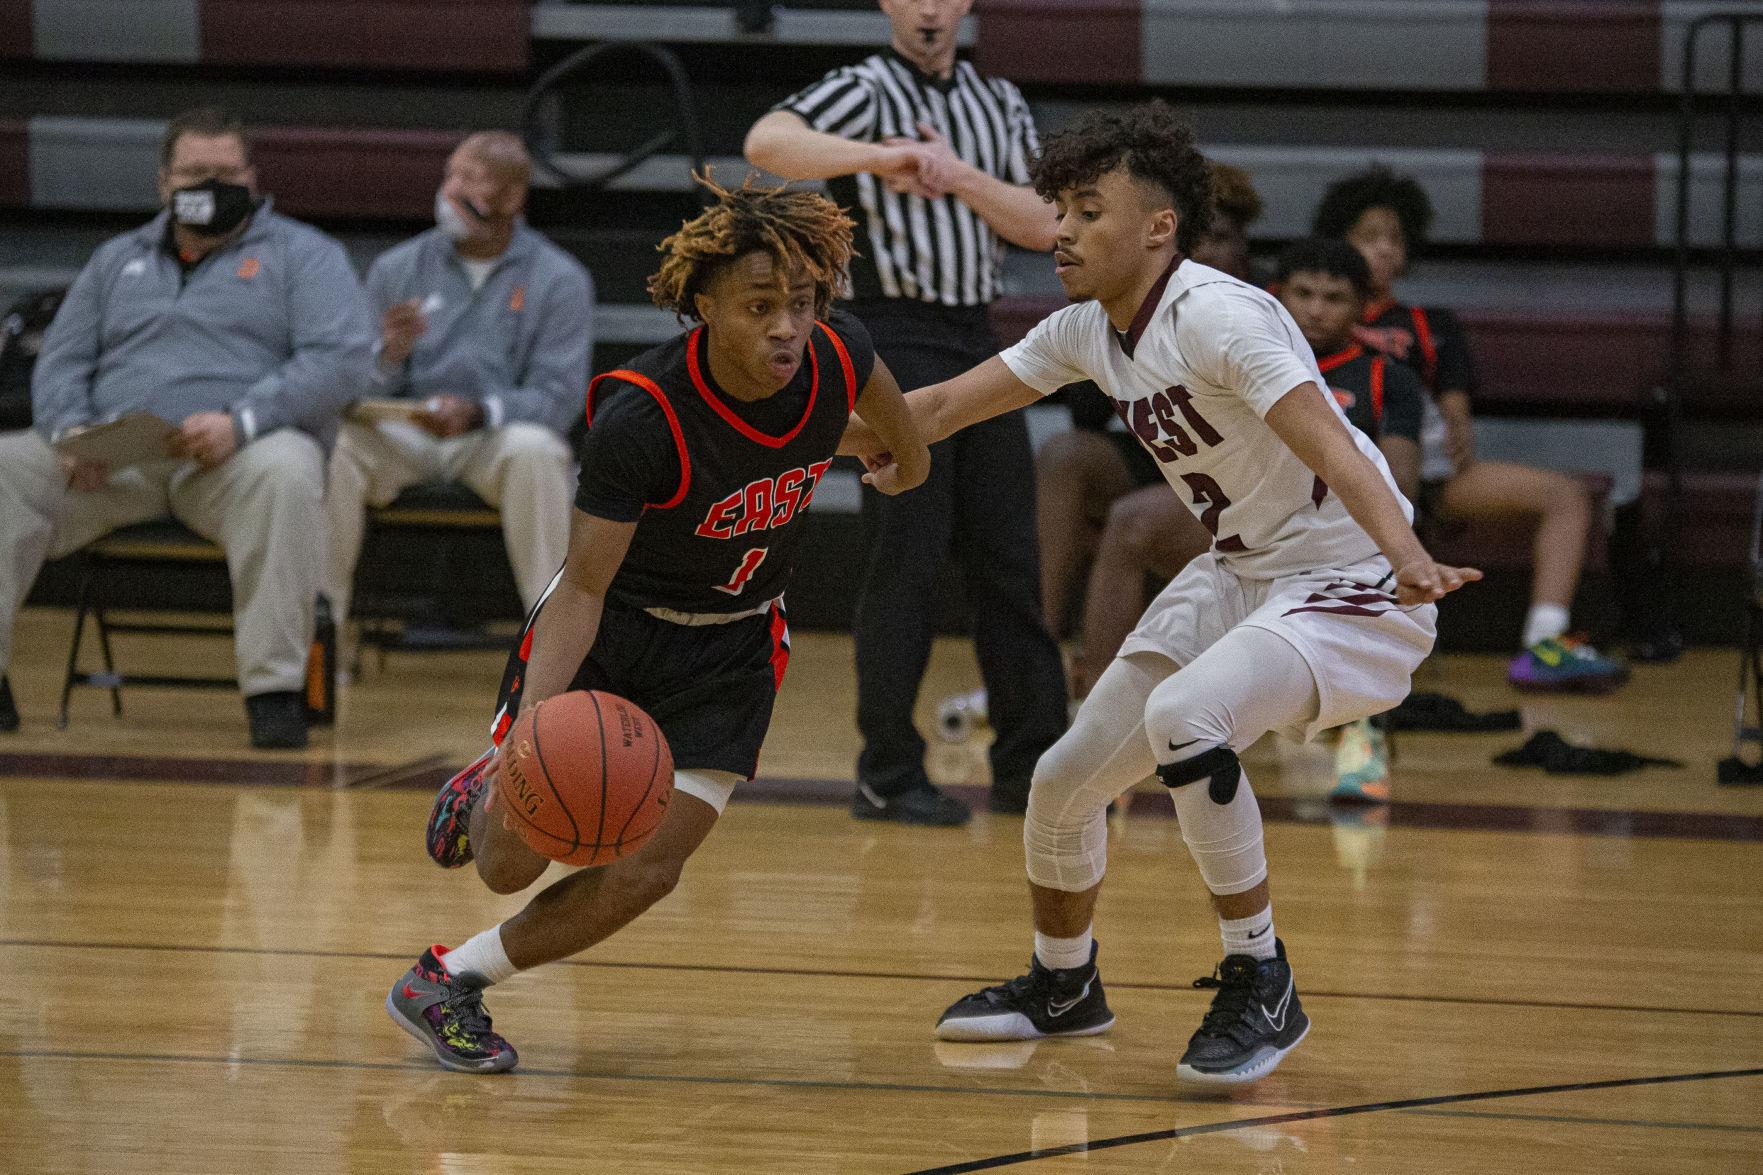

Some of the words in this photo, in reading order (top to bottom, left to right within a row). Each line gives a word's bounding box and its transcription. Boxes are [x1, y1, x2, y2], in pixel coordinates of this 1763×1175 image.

[694, 456, 833, 539] EAST
[1180, 472, 1248, 552] 2
[711, 546, 769, 596] 1
